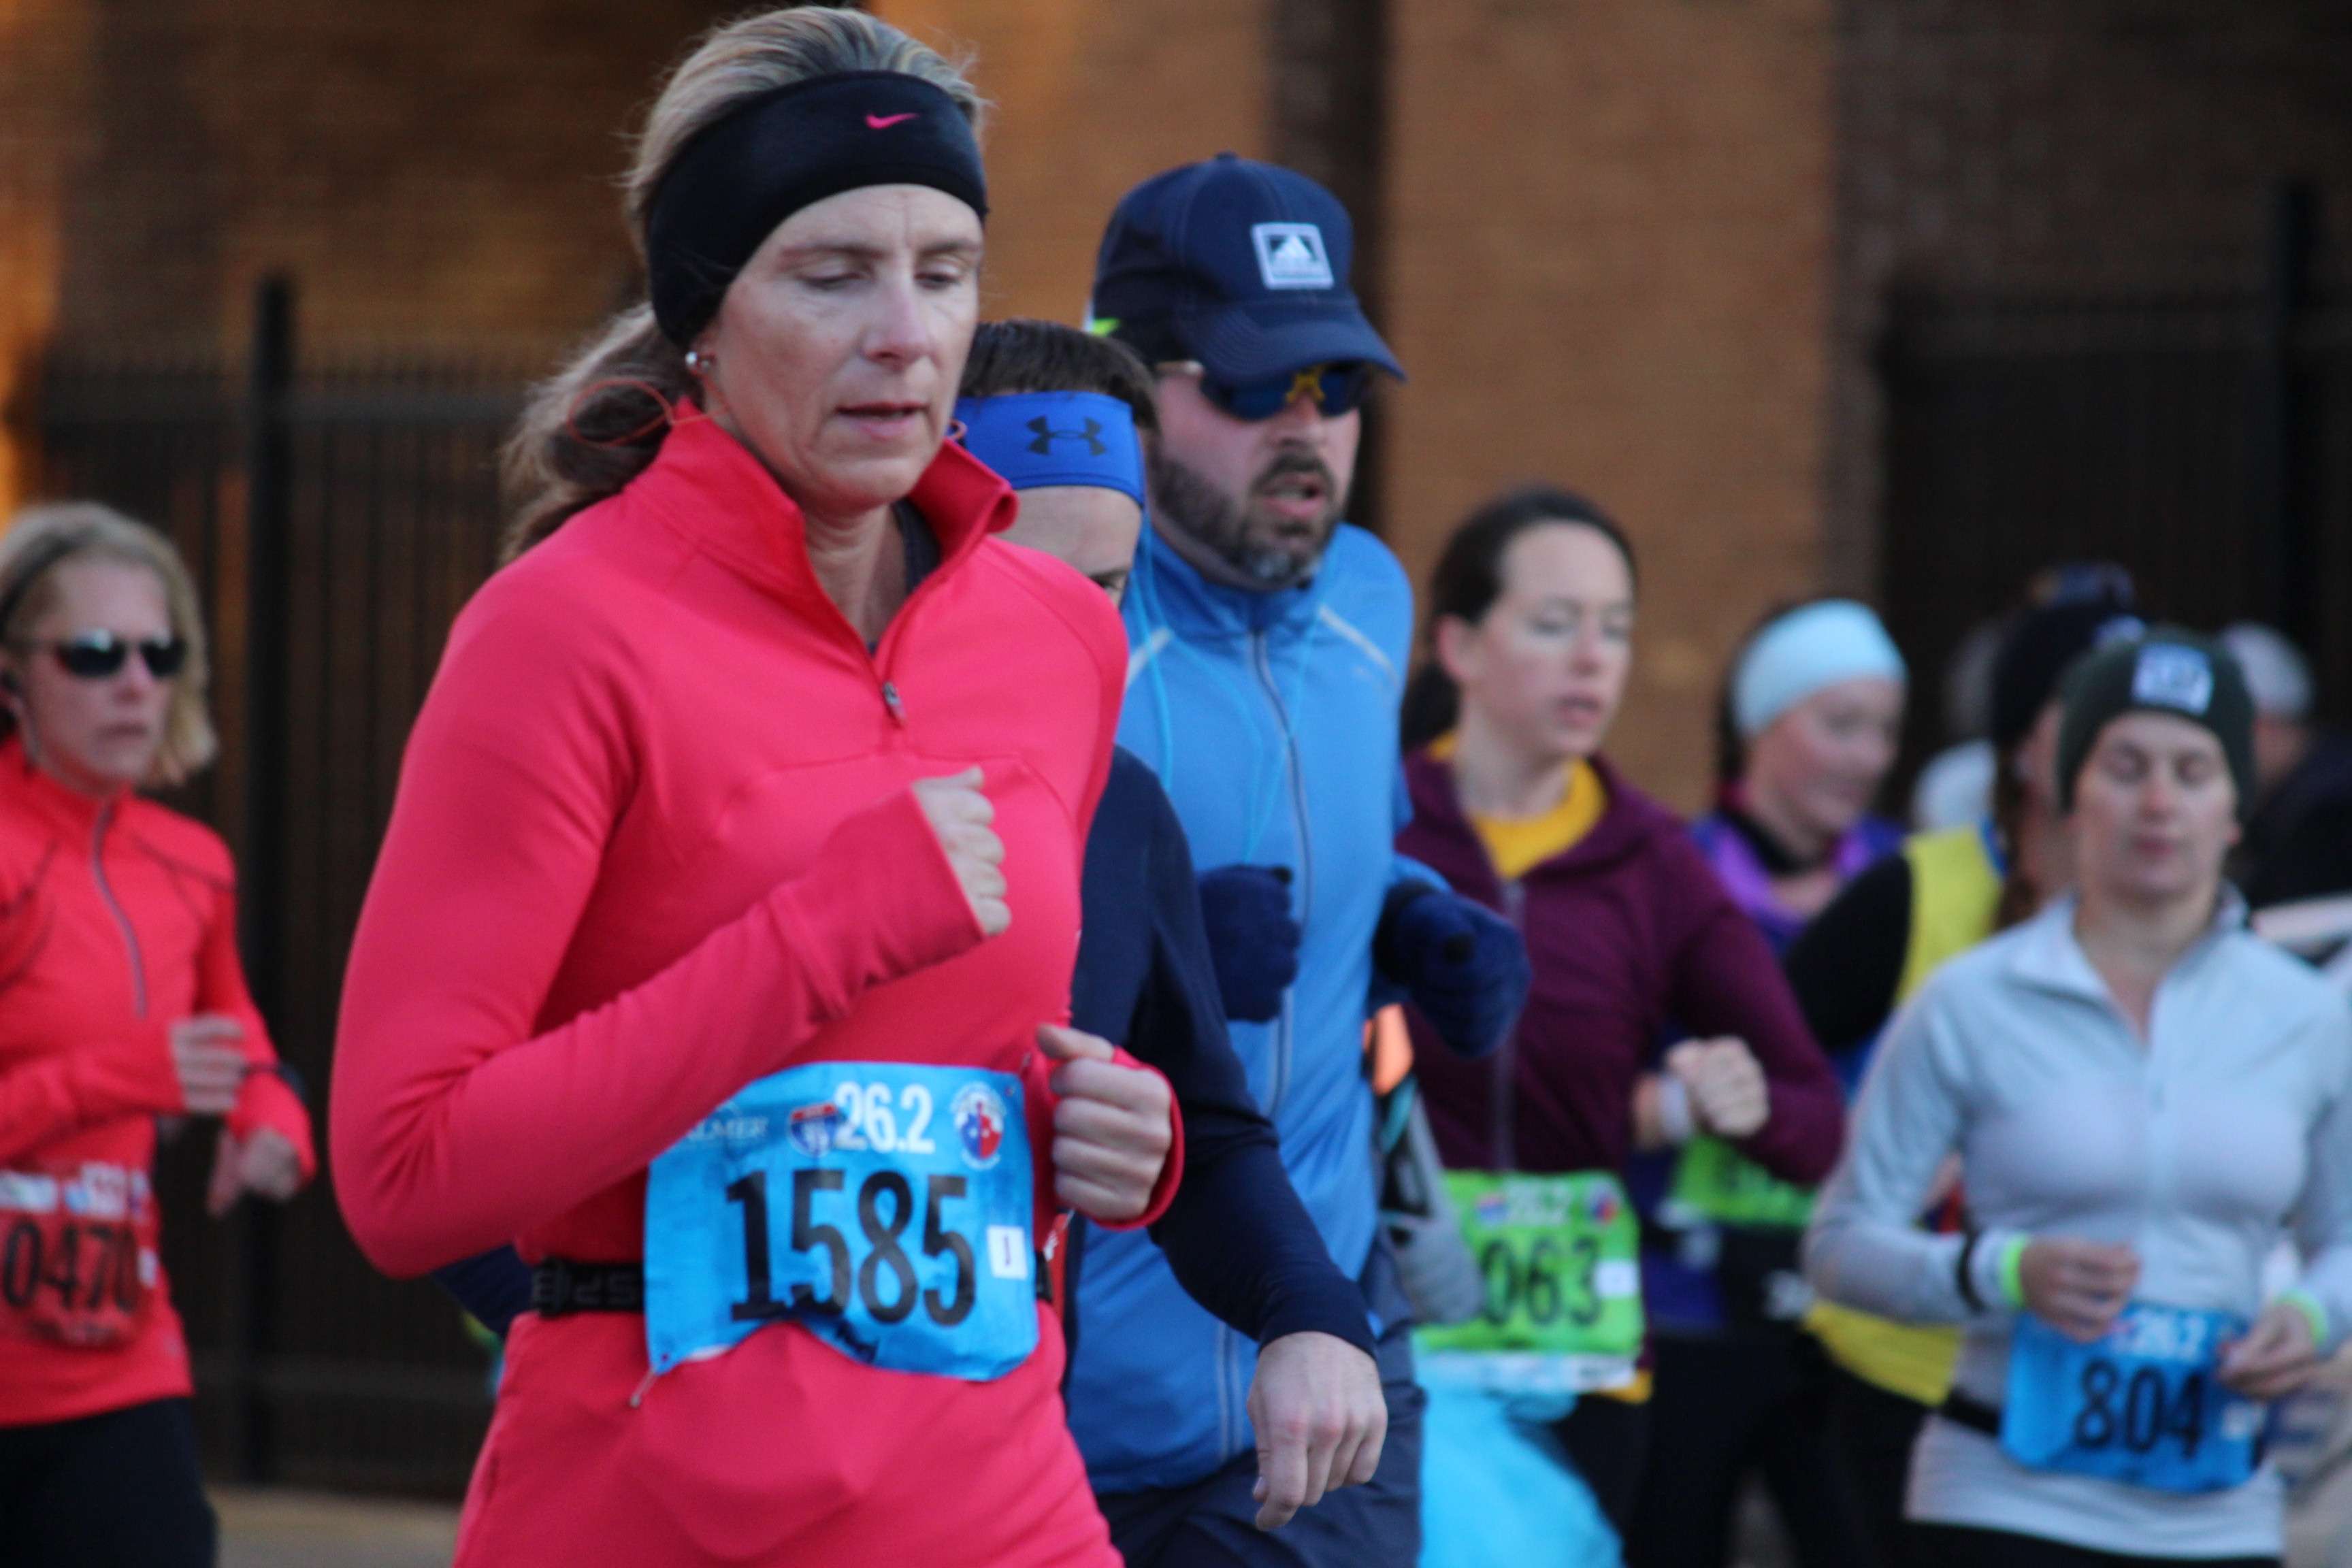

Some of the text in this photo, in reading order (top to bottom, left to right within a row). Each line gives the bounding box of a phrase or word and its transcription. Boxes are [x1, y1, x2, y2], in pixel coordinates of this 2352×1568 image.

[834, 1081, 935, 1154] 26.2
[725, 1169, 975, 1327] 1585
[2074, 1356, 2204, 1460] 804
